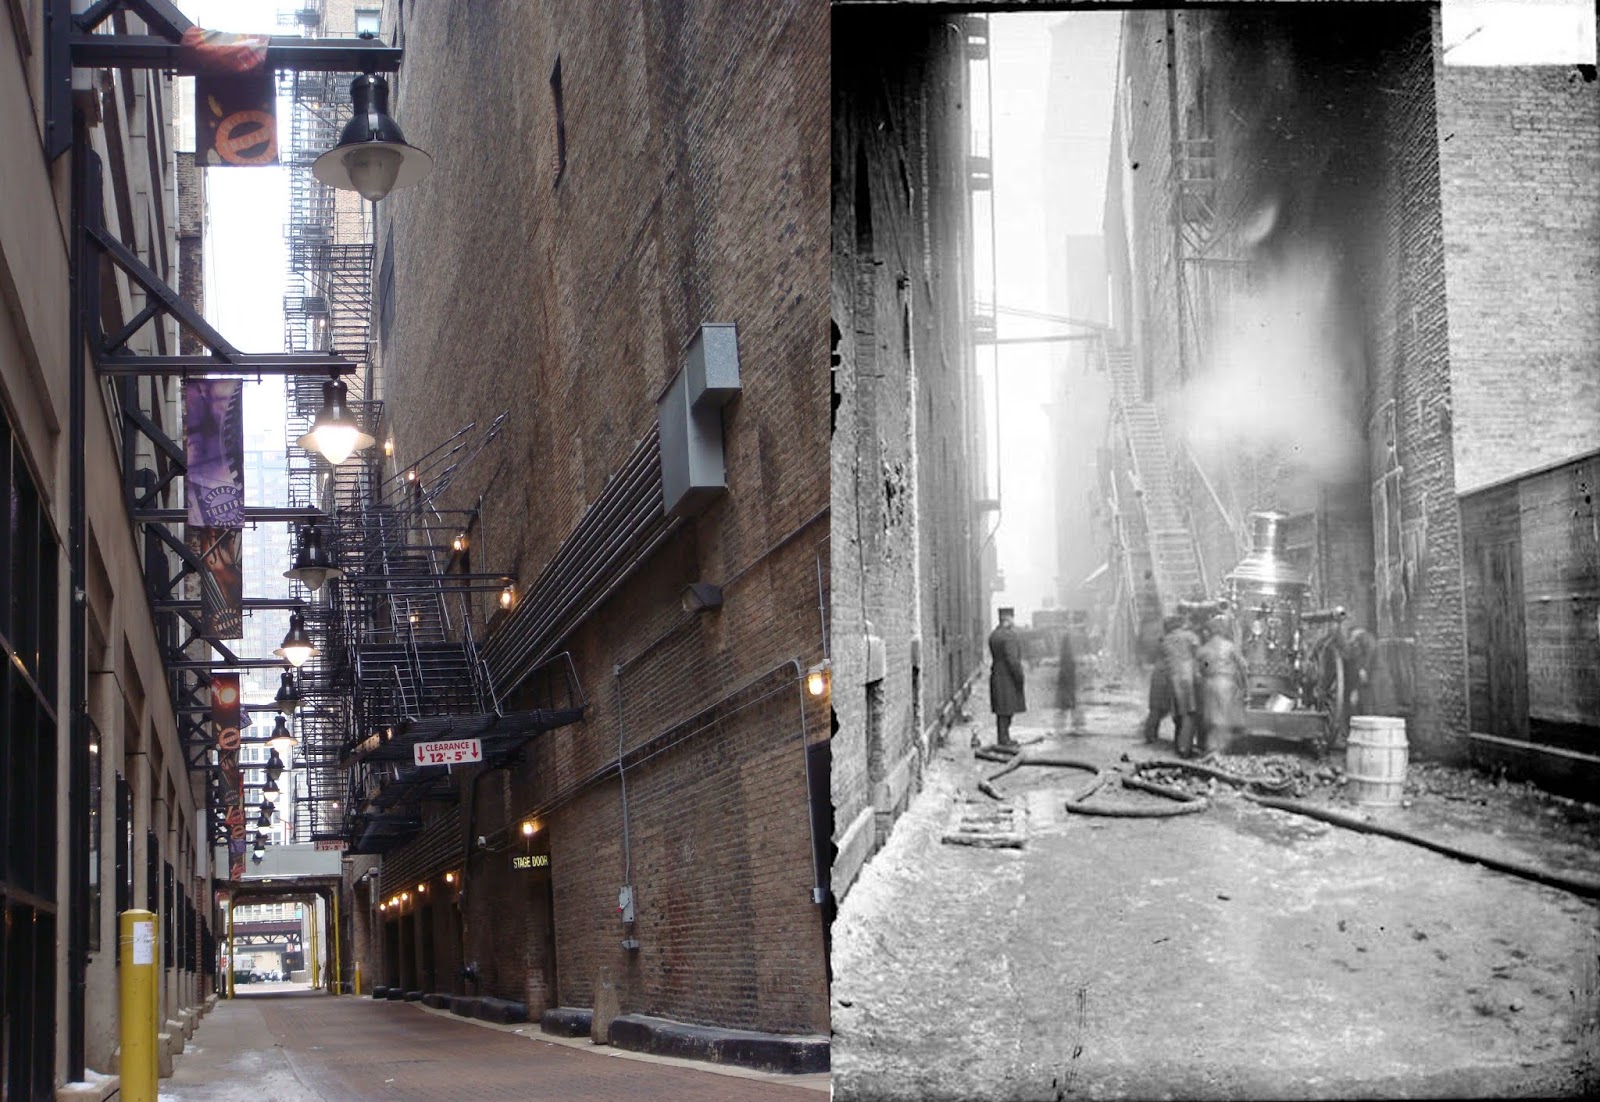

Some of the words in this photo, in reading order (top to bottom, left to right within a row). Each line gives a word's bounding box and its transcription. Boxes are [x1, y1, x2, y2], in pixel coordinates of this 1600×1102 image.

[205, 487, 236, 504] CHICAGO
[206, 497, 244, 518] THEATRE
[425, 741, 470, 752] CLEARANCE
[513, 856, 531, 869] STAGE
[532, 854, 549, 867] DOOR
